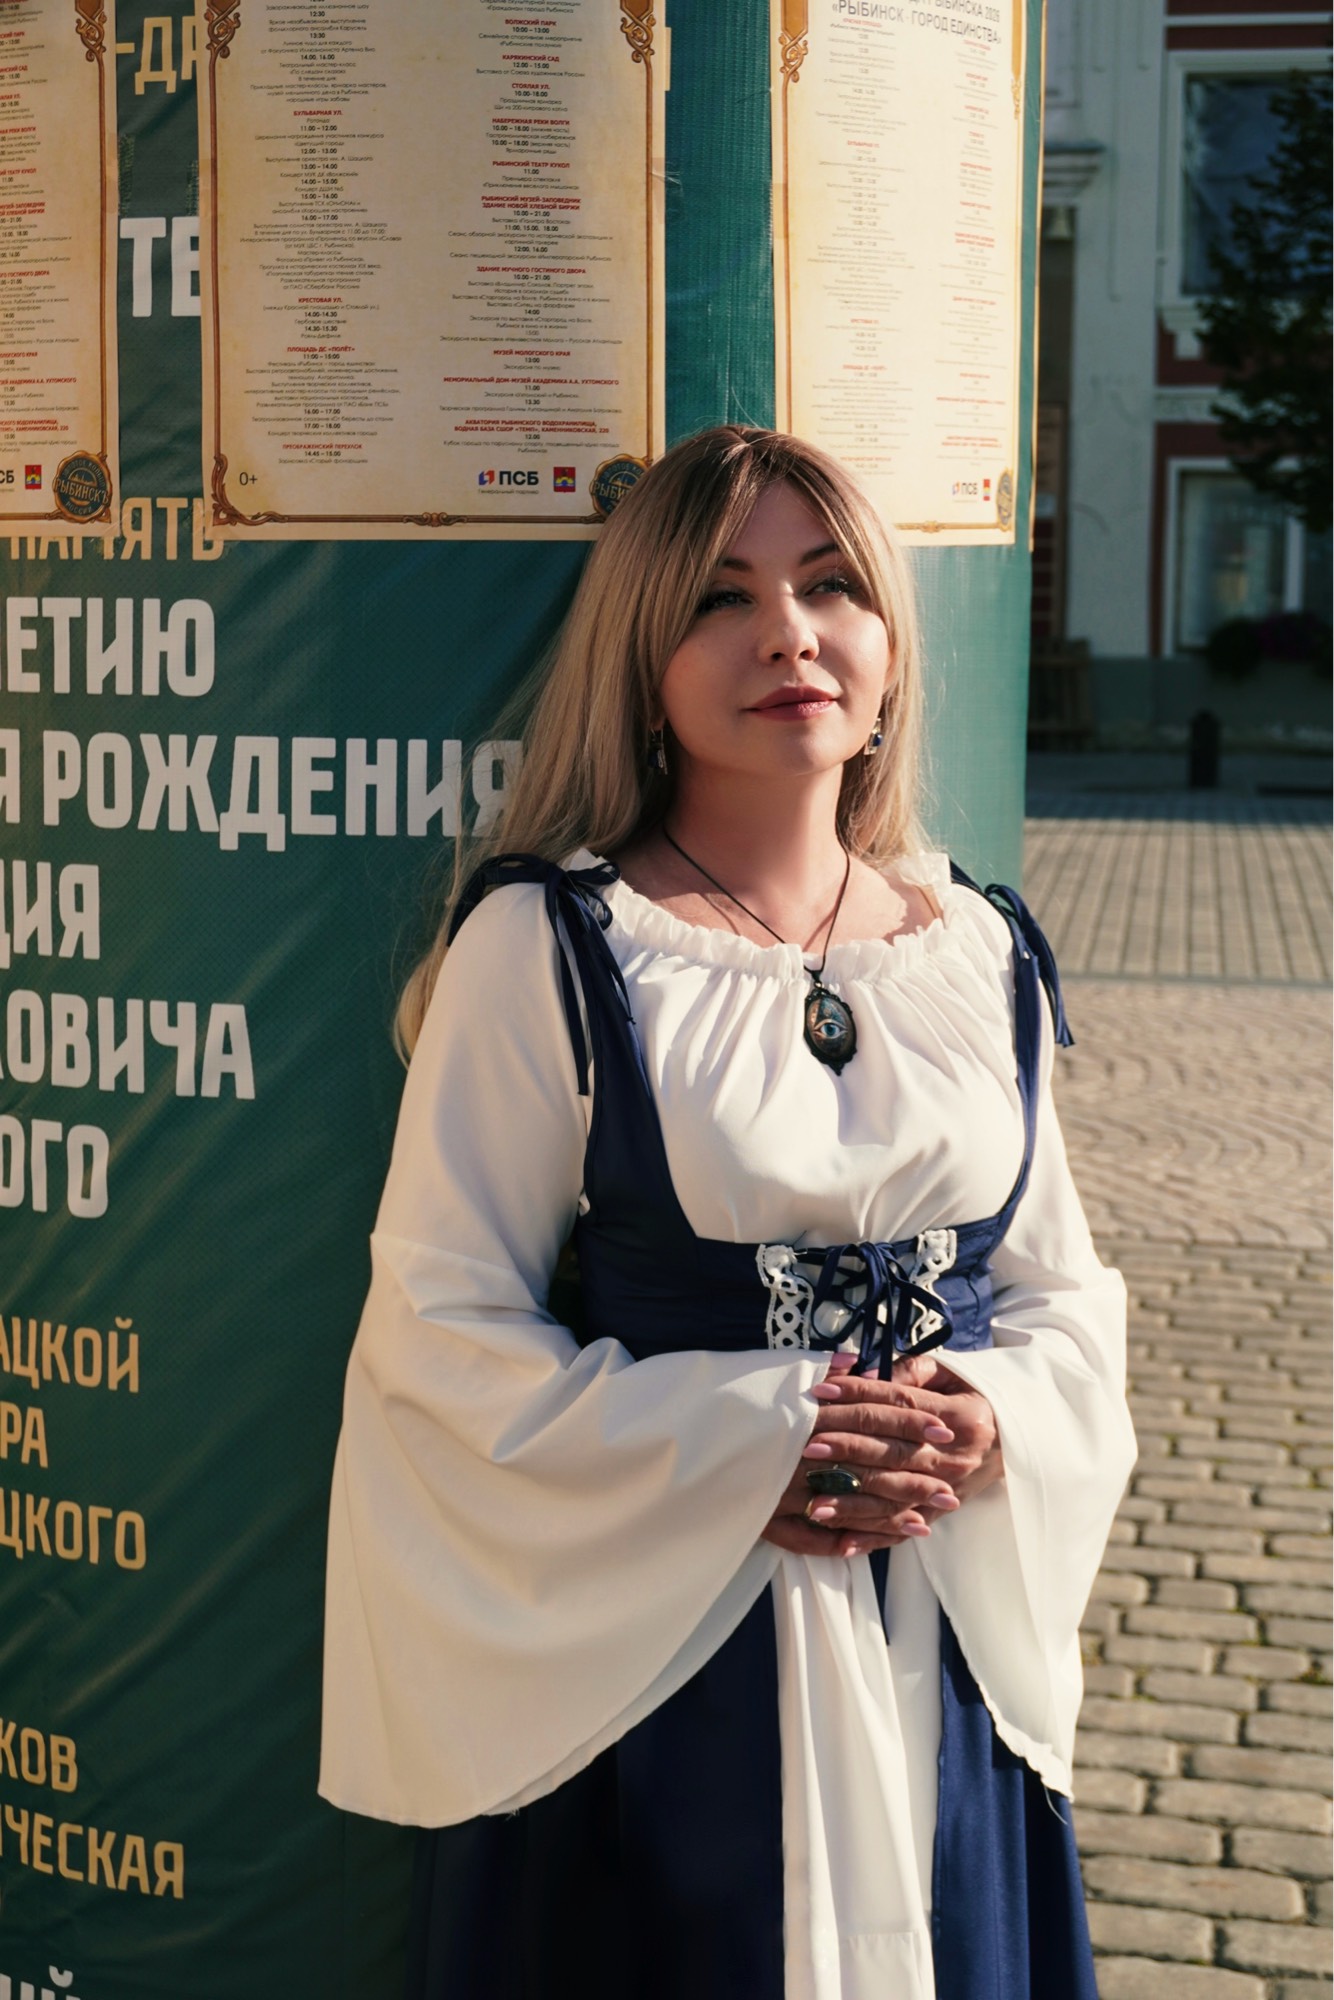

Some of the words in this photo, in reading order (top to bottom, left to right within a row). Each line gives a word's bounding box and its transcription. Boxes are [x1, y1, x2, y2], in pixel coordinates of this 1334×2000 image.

[911, 10, 948, 32] ГОРОД
[239, 472, 257, 485] 0+
[499, 470, 538, 486] ПСБ
[43, 730, 524, 852] РОЖДЕНИЯ
[0, 859, 100, 969] ИЯ
